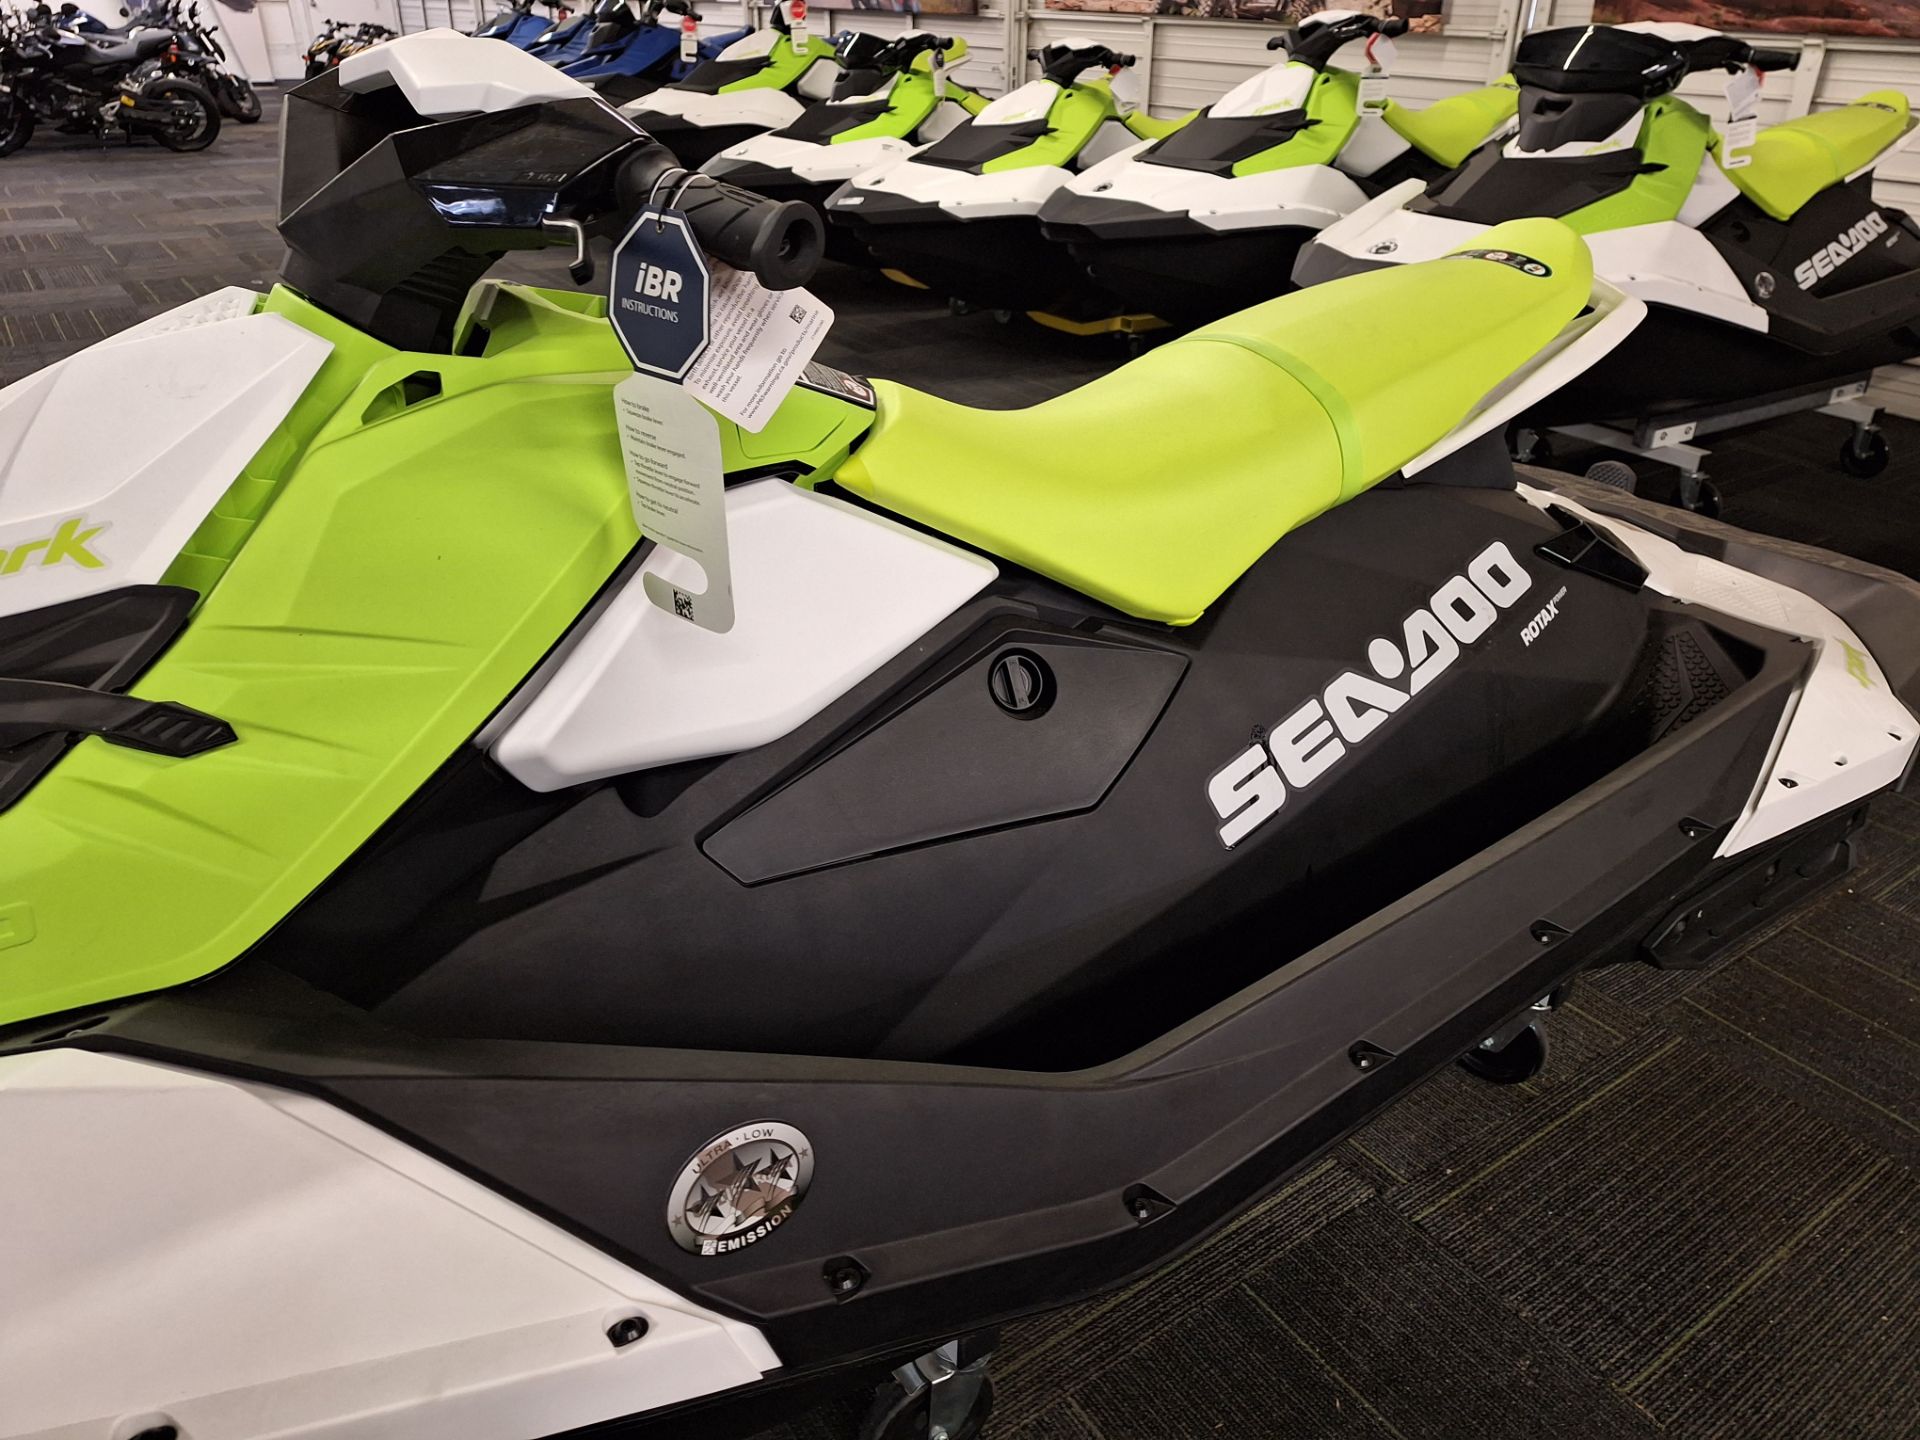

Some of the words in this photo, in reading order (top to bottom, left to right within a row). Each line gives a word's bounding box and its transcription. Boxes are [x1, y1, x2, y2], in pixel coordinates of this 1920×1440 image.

[635, 262, 683, 303] iBR
[621, 297, 679, 323] INSTRUCTIONS
[1520, 599, 1559, 647] ROTAX
[693, 1139, 732, 1175] ULTRA
[743, 1128, 774, 1141] LOW
[717, 1204, 793, 1253] EMISSION
